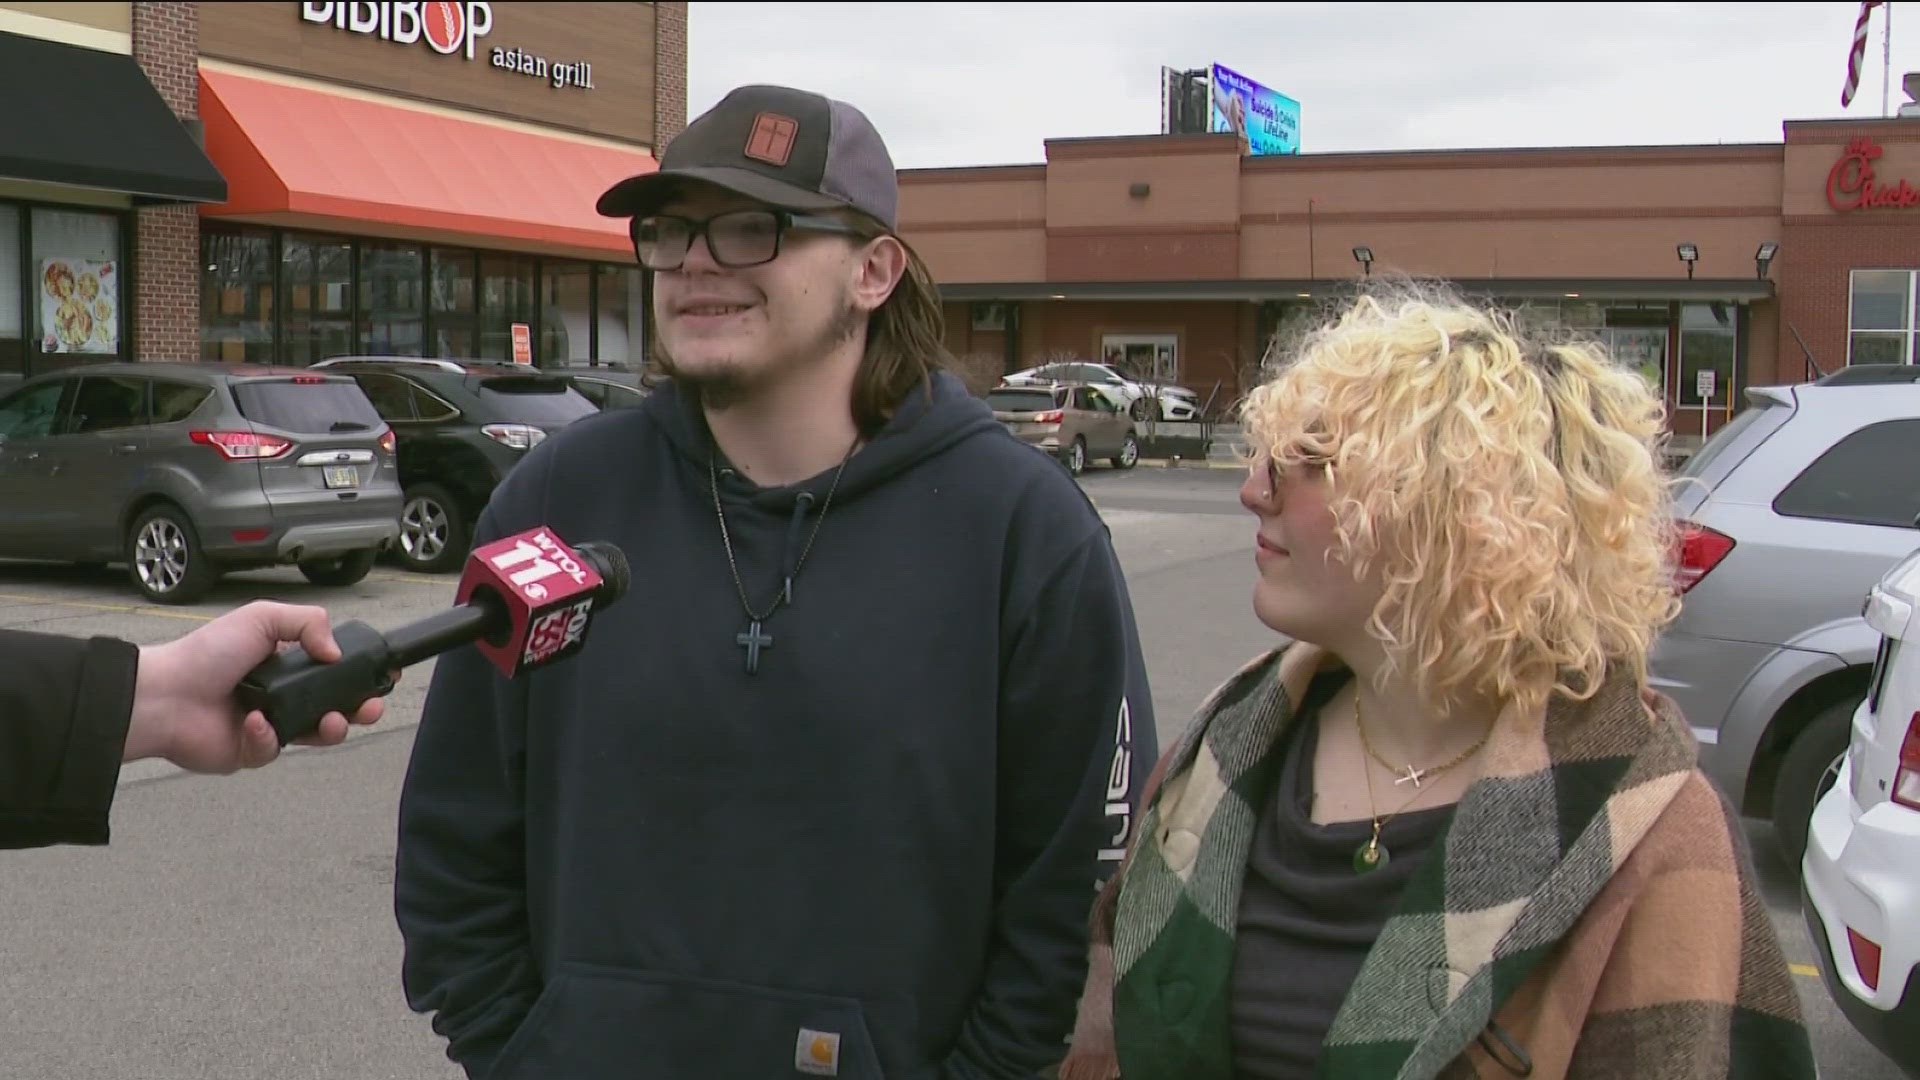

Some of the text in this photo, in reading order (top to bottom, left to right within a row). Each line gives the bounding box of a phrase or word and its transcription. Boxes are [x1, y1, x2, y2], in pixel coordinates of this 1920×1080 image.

[493, 47, 547, 78] asian
[1251, 97, 1274, 120] Suicide
[490, 540, 562, 586] 11
[533, 532, 587, 585] WTOL
[561, 598, 593, 650] FOX
